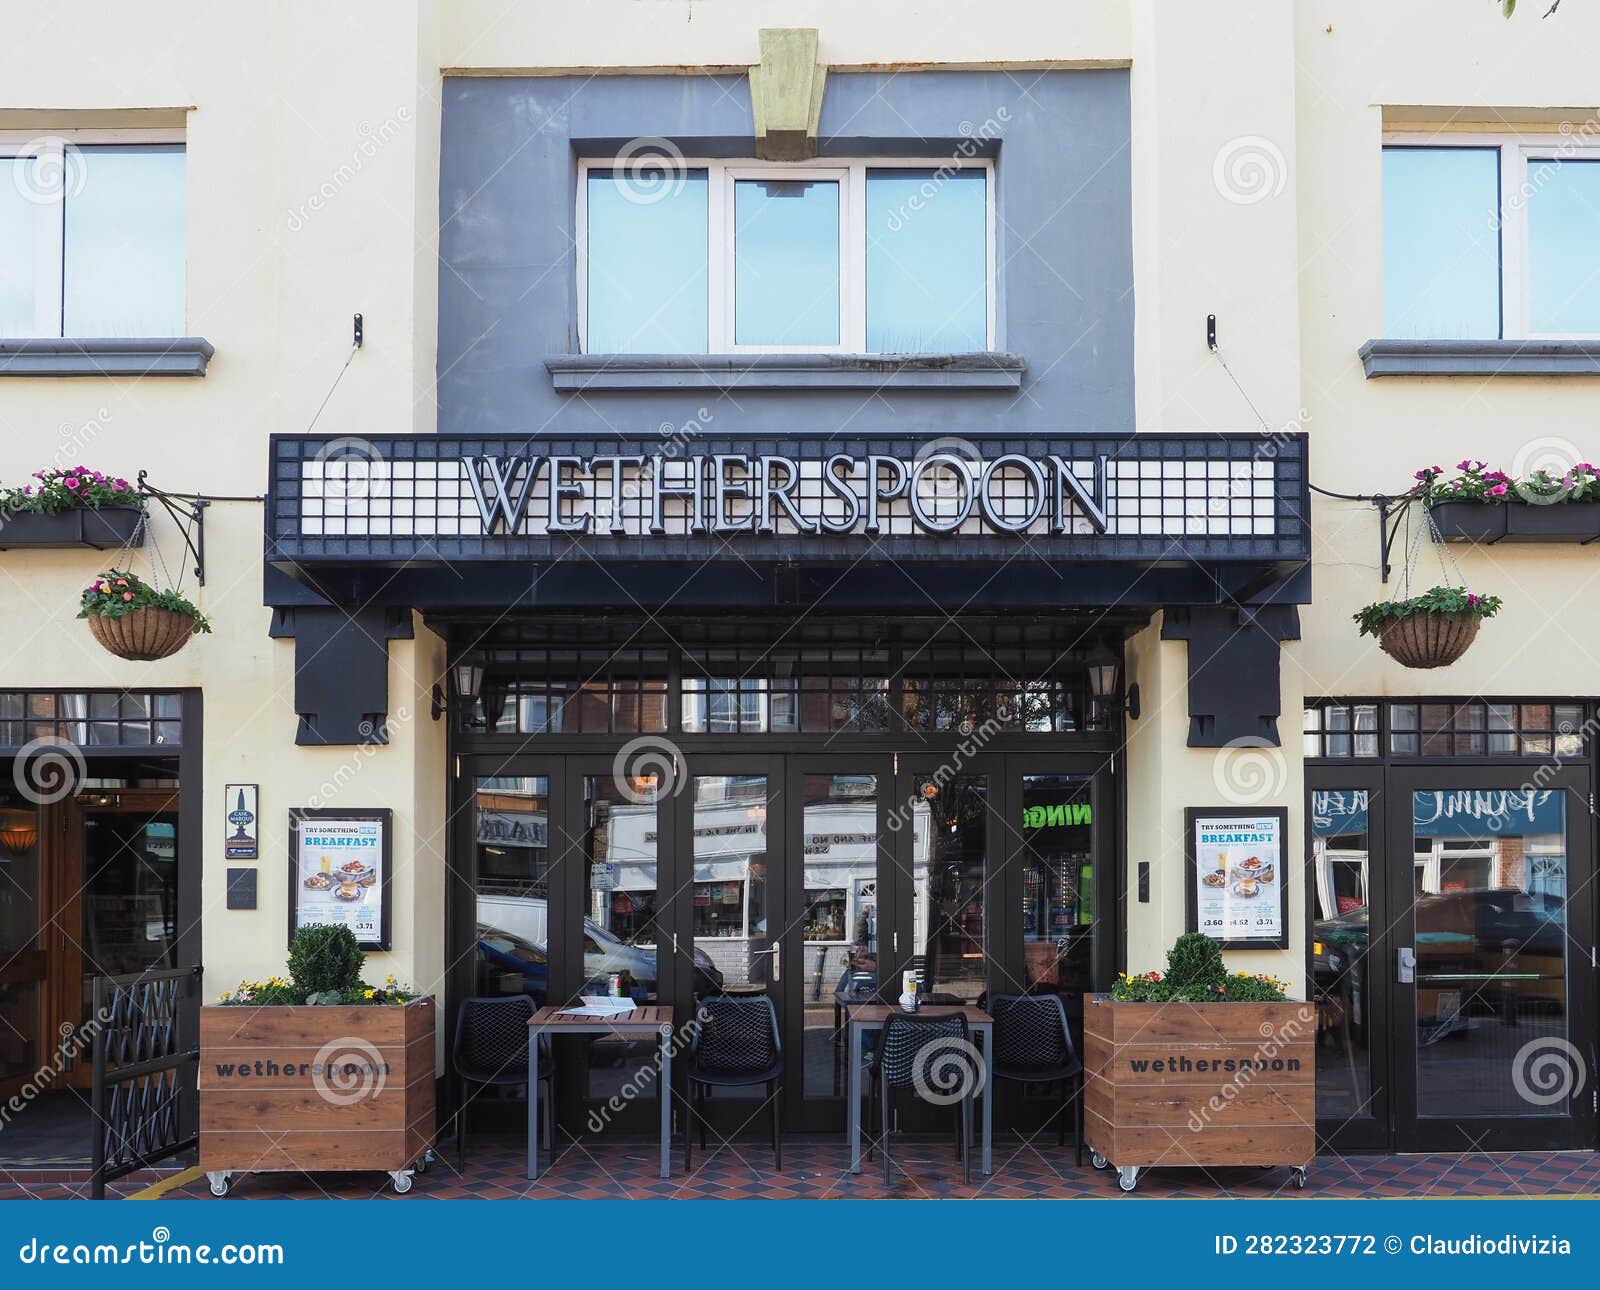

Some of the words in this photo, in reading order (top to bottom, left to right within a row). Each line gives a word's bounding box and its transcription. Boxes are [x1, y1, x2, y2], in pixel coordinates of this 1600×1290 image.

[459, 452, 1109, 535] WETHERSPOON
[305, 837, 377, 846] BREAKFAST
[1201, 833, 1273, 843] BREAKFAST
[216, 1059, 390, 1080] wetherspoon
[1130, 1055, 1301, 1074] wetherspoon
